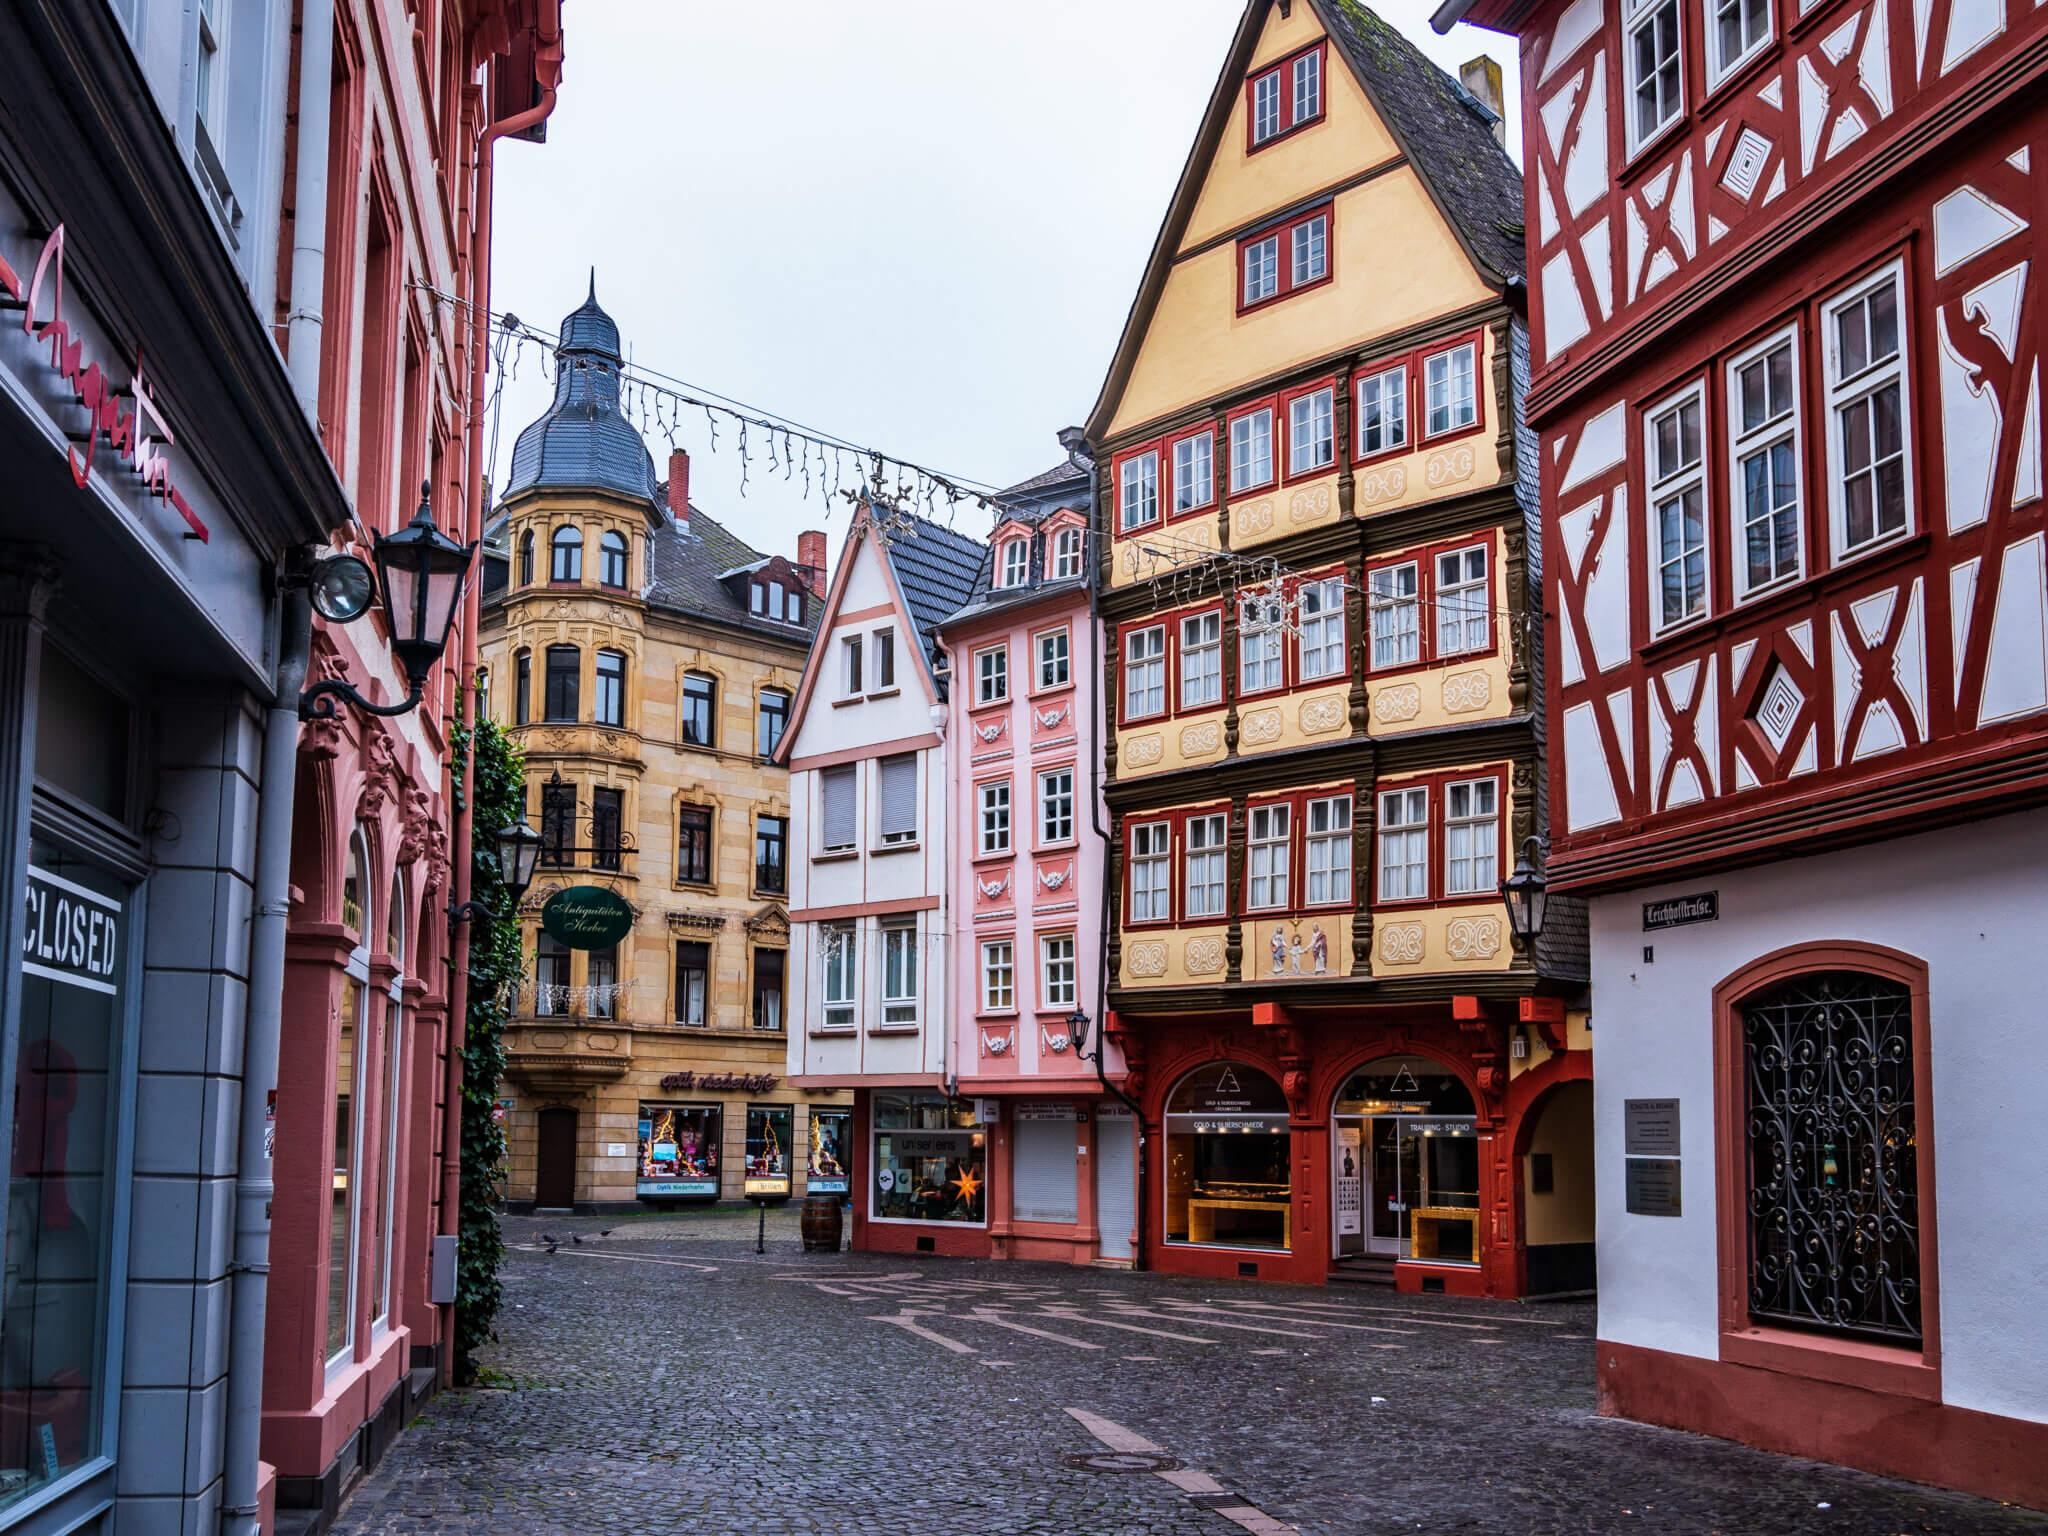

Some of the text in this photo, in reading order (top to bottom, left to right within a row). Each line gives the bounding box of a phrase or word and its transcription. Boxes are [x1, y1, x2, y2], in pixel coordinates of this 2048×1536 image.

[550, 902, 624, 918] Antiquitäten
[22, 885, 117, 976] CLOSED
[1193, 1121, 1210, 1129] GOLD
[1217, 1121, 1264, 1129] SILBERSCHMIEDE
